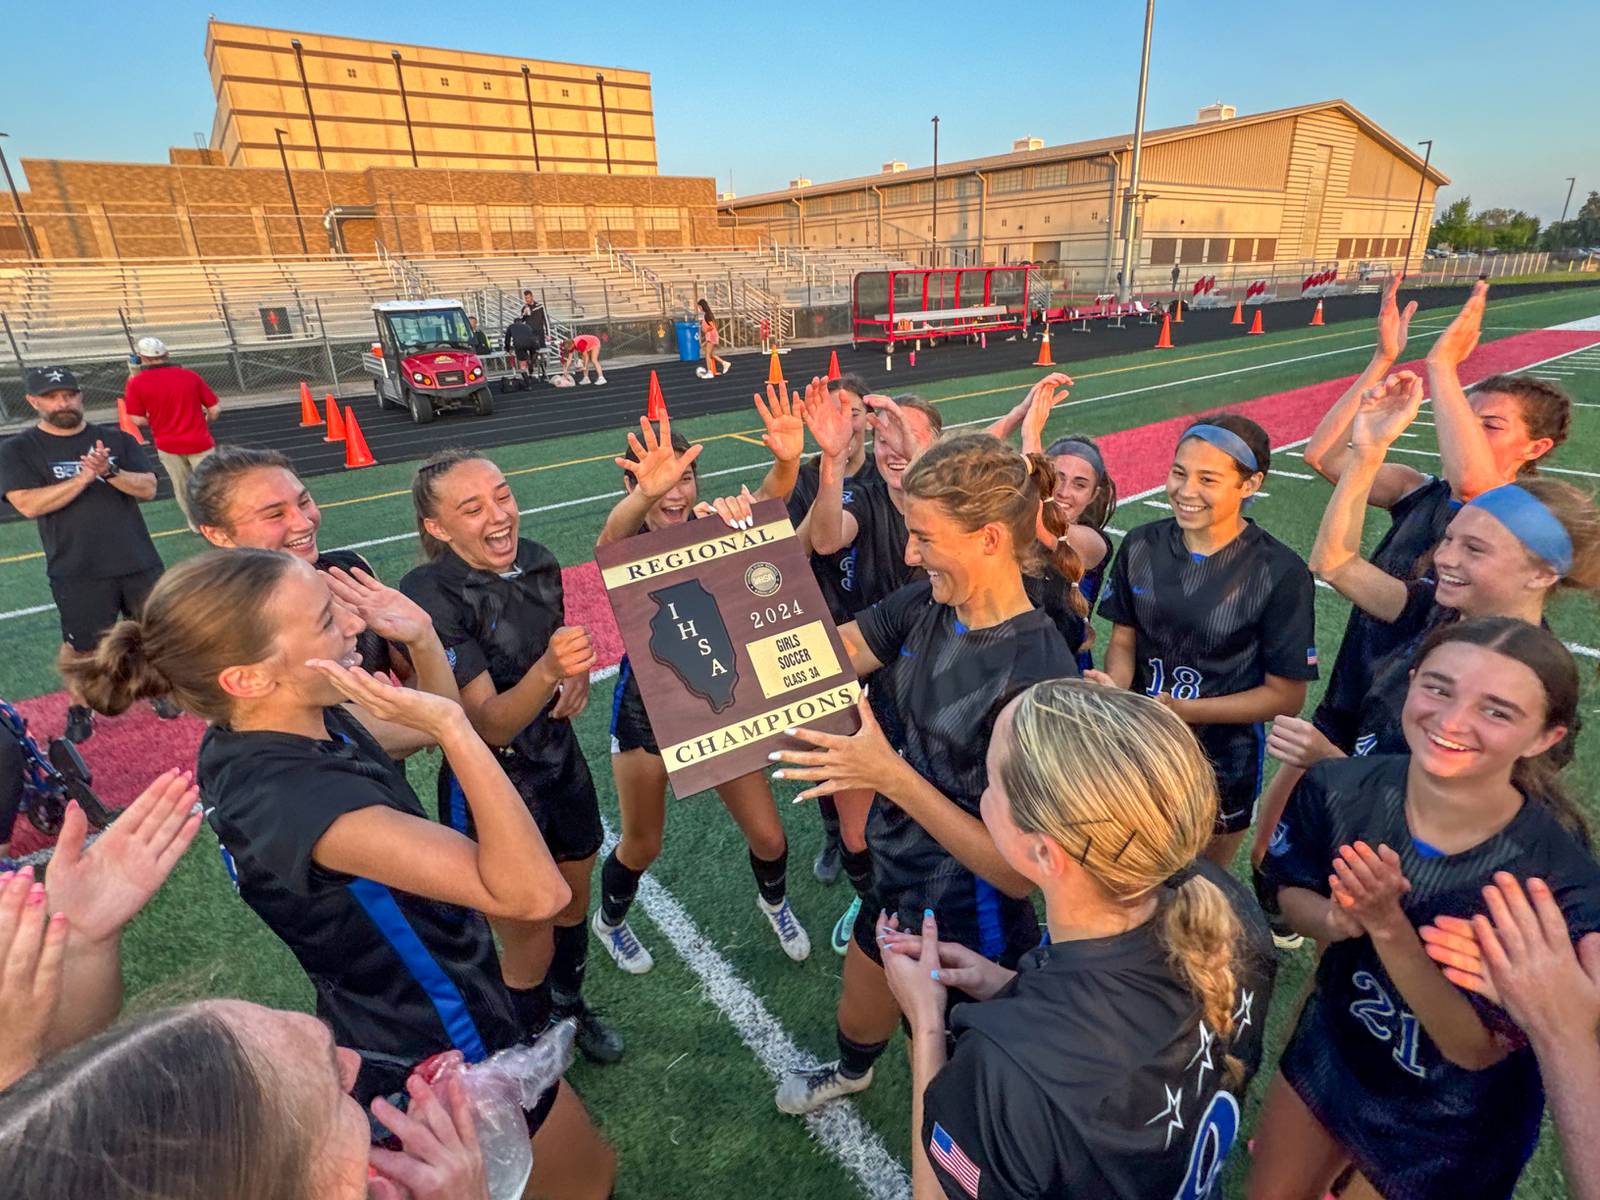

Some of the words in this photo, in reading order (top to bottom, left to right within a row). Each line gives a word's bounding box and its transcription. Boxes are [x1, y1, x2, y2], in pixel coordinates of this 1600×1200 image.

[627, 528, 775, 580] REGIONAL
[750, 599, 804, 629] 2024
[668, 602, 728, 677] IHSA
[775, 633, 801, 653] GIRLS
[777, 648, 812, 670] SOCCER
[783, 670, 808, 688] CLASS
[808, 666, 821, 679] 3A
[1145, 657, 1204, 700] 18
[675, 687, 853, 763] CHAMPIONS
[1349, 970, 1426, 1078] 21
